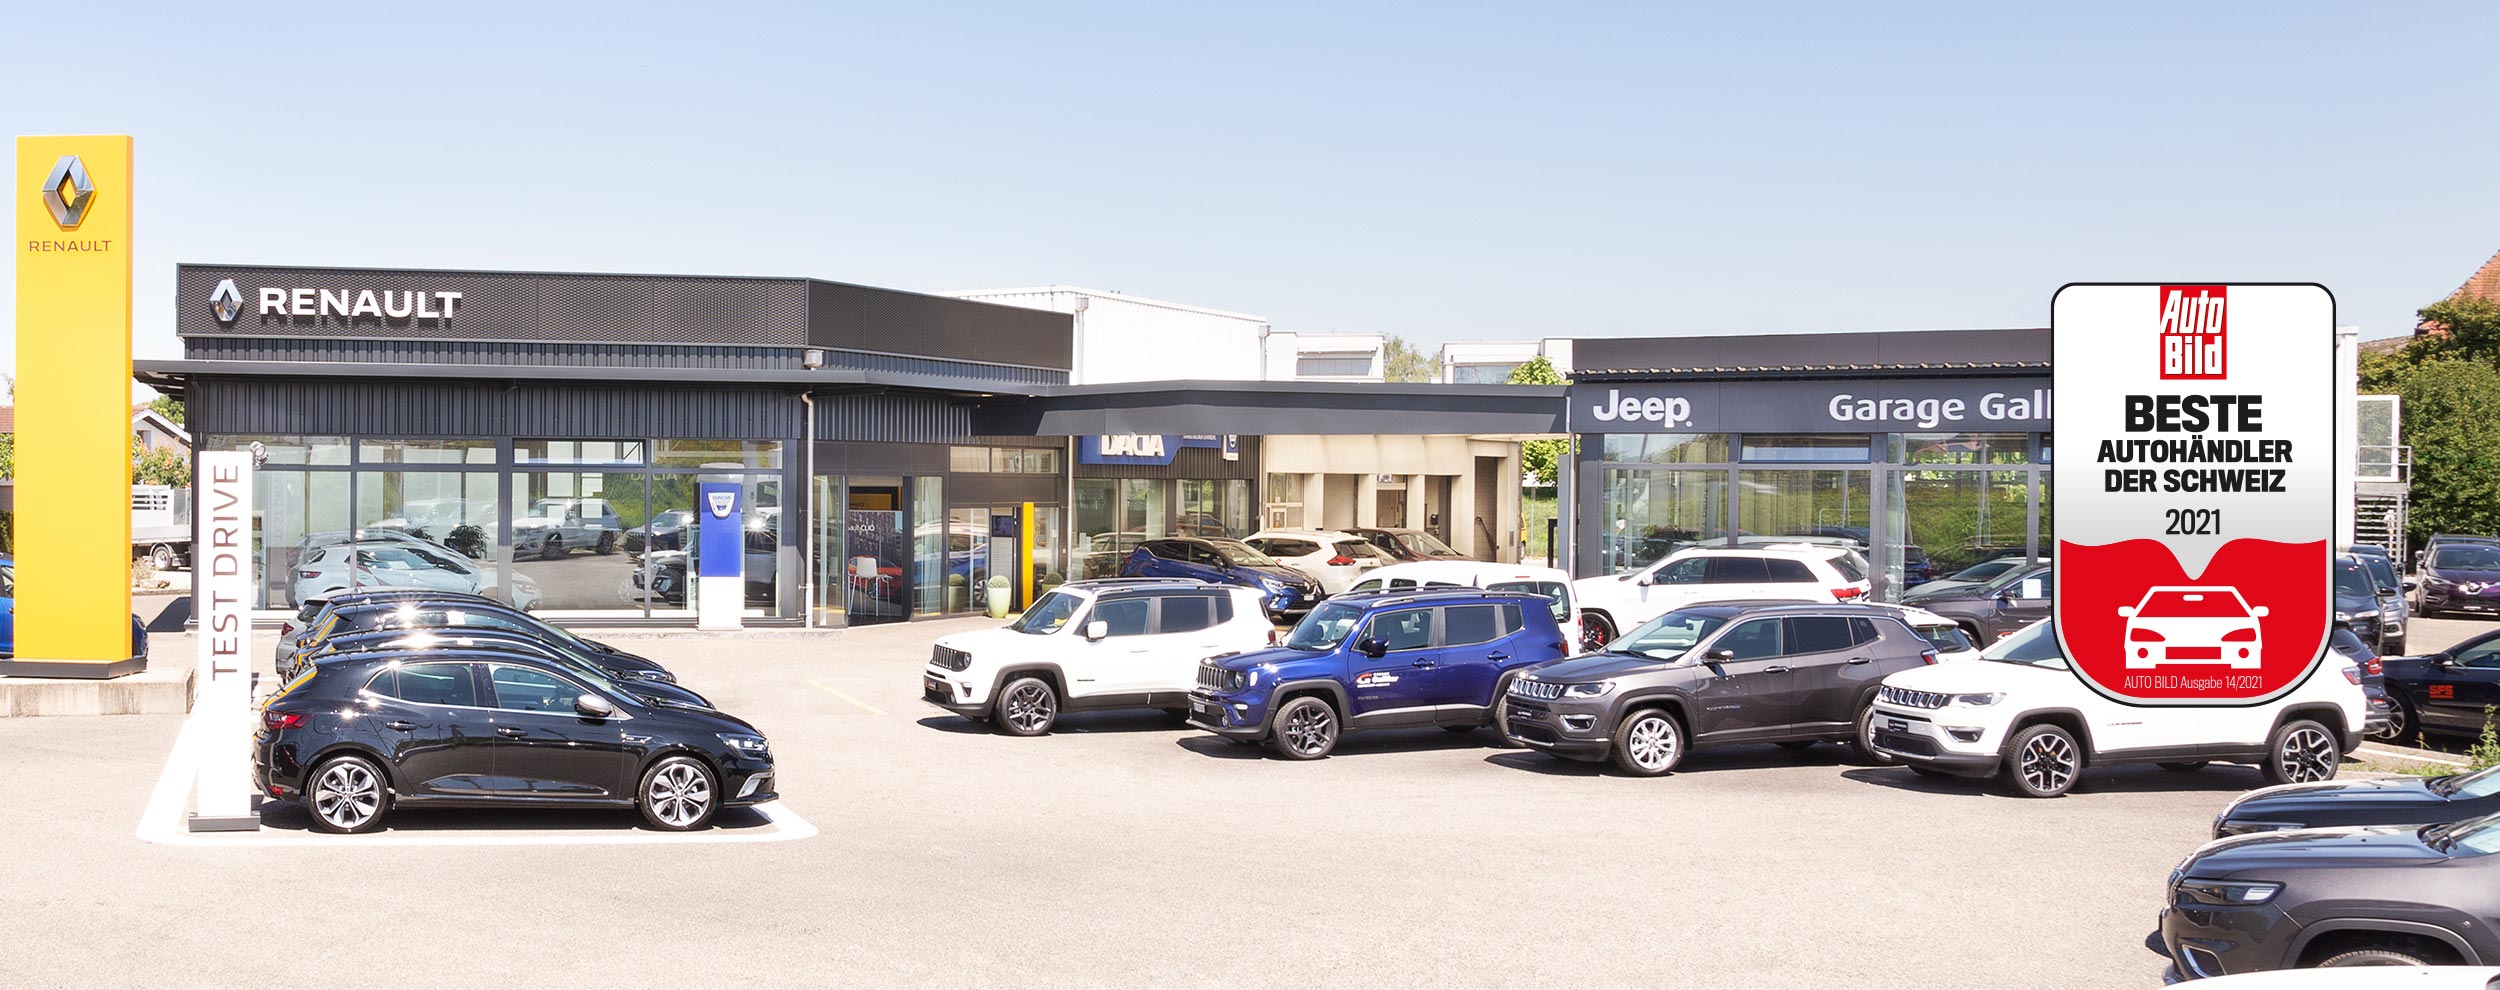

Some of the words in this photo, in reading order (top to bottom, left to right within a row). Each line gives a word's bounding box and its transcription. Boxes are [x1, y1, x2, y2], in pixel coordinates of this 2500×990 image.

[29, 240, 112, 252] RENAULT
[259, 287, 463, 319] RENAULT
[1828, 394, 1965, 429] Garage
[212, 465, 239, 577] DRIVE
[212, 588, 239, 681] TEST
